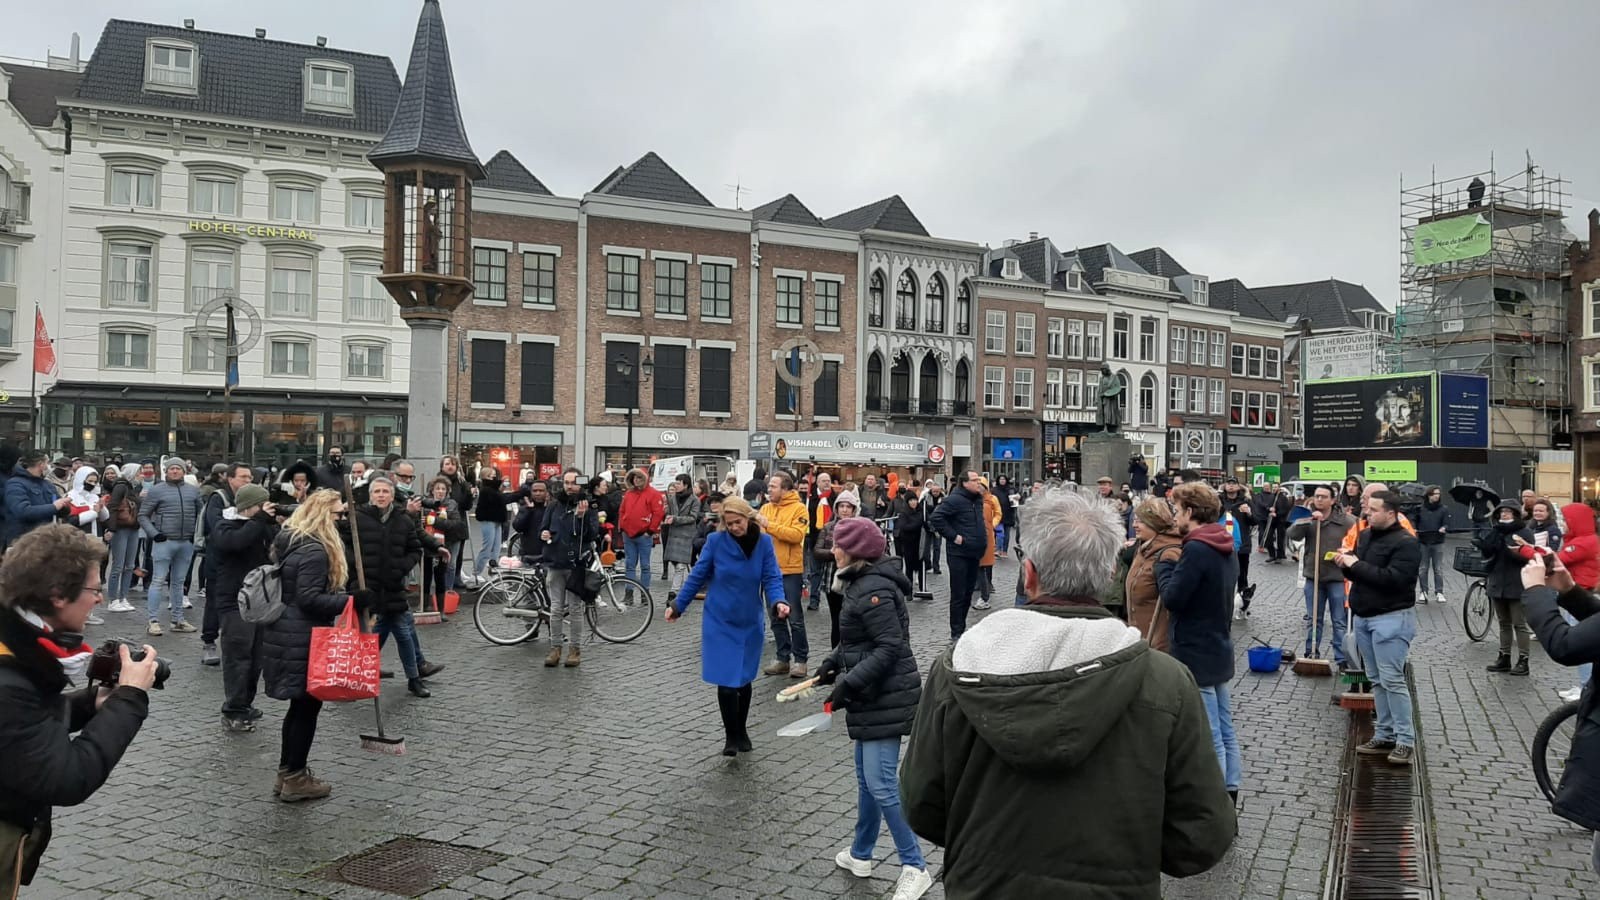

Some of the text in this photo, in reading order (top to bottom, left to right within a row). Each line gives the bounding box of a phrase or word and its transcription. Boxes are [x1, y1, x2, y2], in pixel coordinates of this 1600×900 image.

[189, 220, 316, 241] HOTEL CENTRAL
[1309, 334, 1375, 347] HIER HERBOUWEN
[1310, 342, 1375, 356] WE HET VERLEDEN
[787, 439, 914, 450] VISHANDEL GEPKENS-ERNST
[491, 449, 519, 460] SALE
